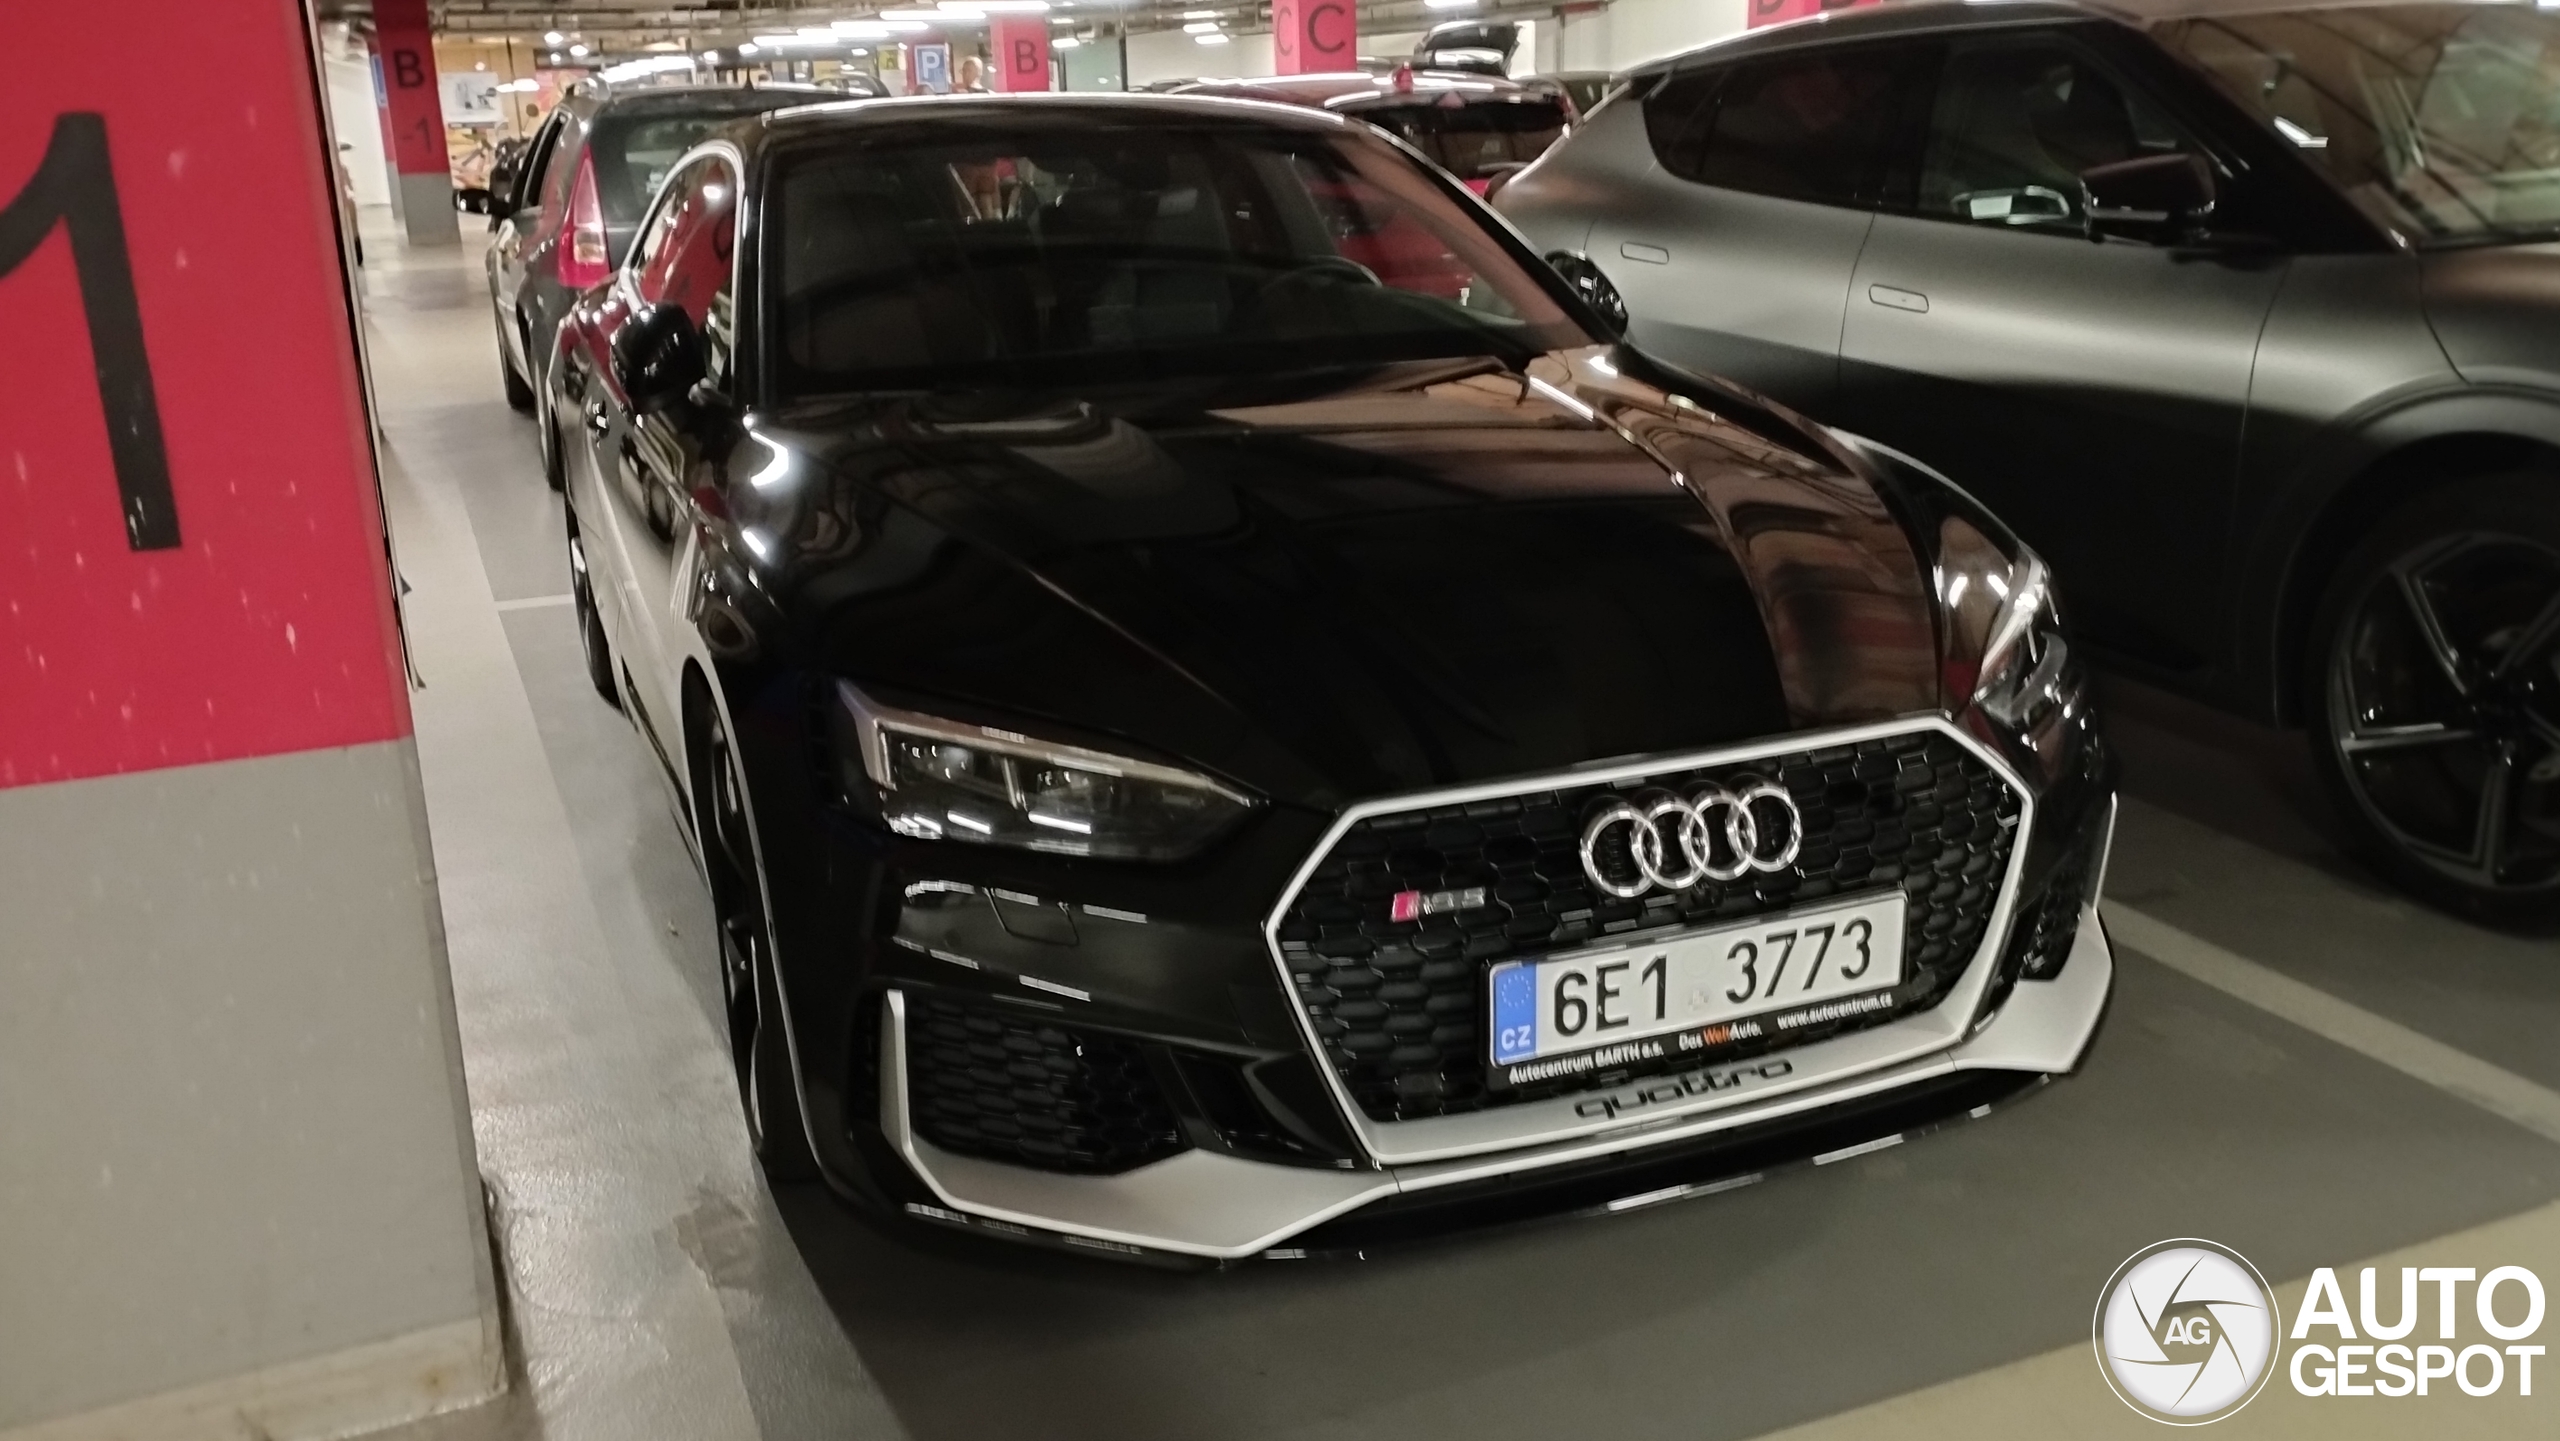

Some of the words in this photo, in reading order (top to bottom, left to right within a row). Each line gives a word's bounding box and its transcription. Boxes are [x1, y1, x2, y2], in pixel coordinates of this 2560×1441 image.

[1308, 4, 1346, 54] C
[394, 50, 425, 88] B
[921, 51, 940, 80] P
[1014, 39, 1039, 74] B
[402, 117, 432, 153] -1
[1553, 954, 1668, 1037] 6E1
[1726, 916, 1874, 1004] 3773
[1777, 991, 1893, 1030] www.autocentrum.cz
[1501, 1025, 1531, 1052] CZ
[1509, 1054, 1594, 1085] Autocentrum
[1595, 1041, 1640, 1068] BARTH
[1574, 1058, 1793, 1119] quattro
